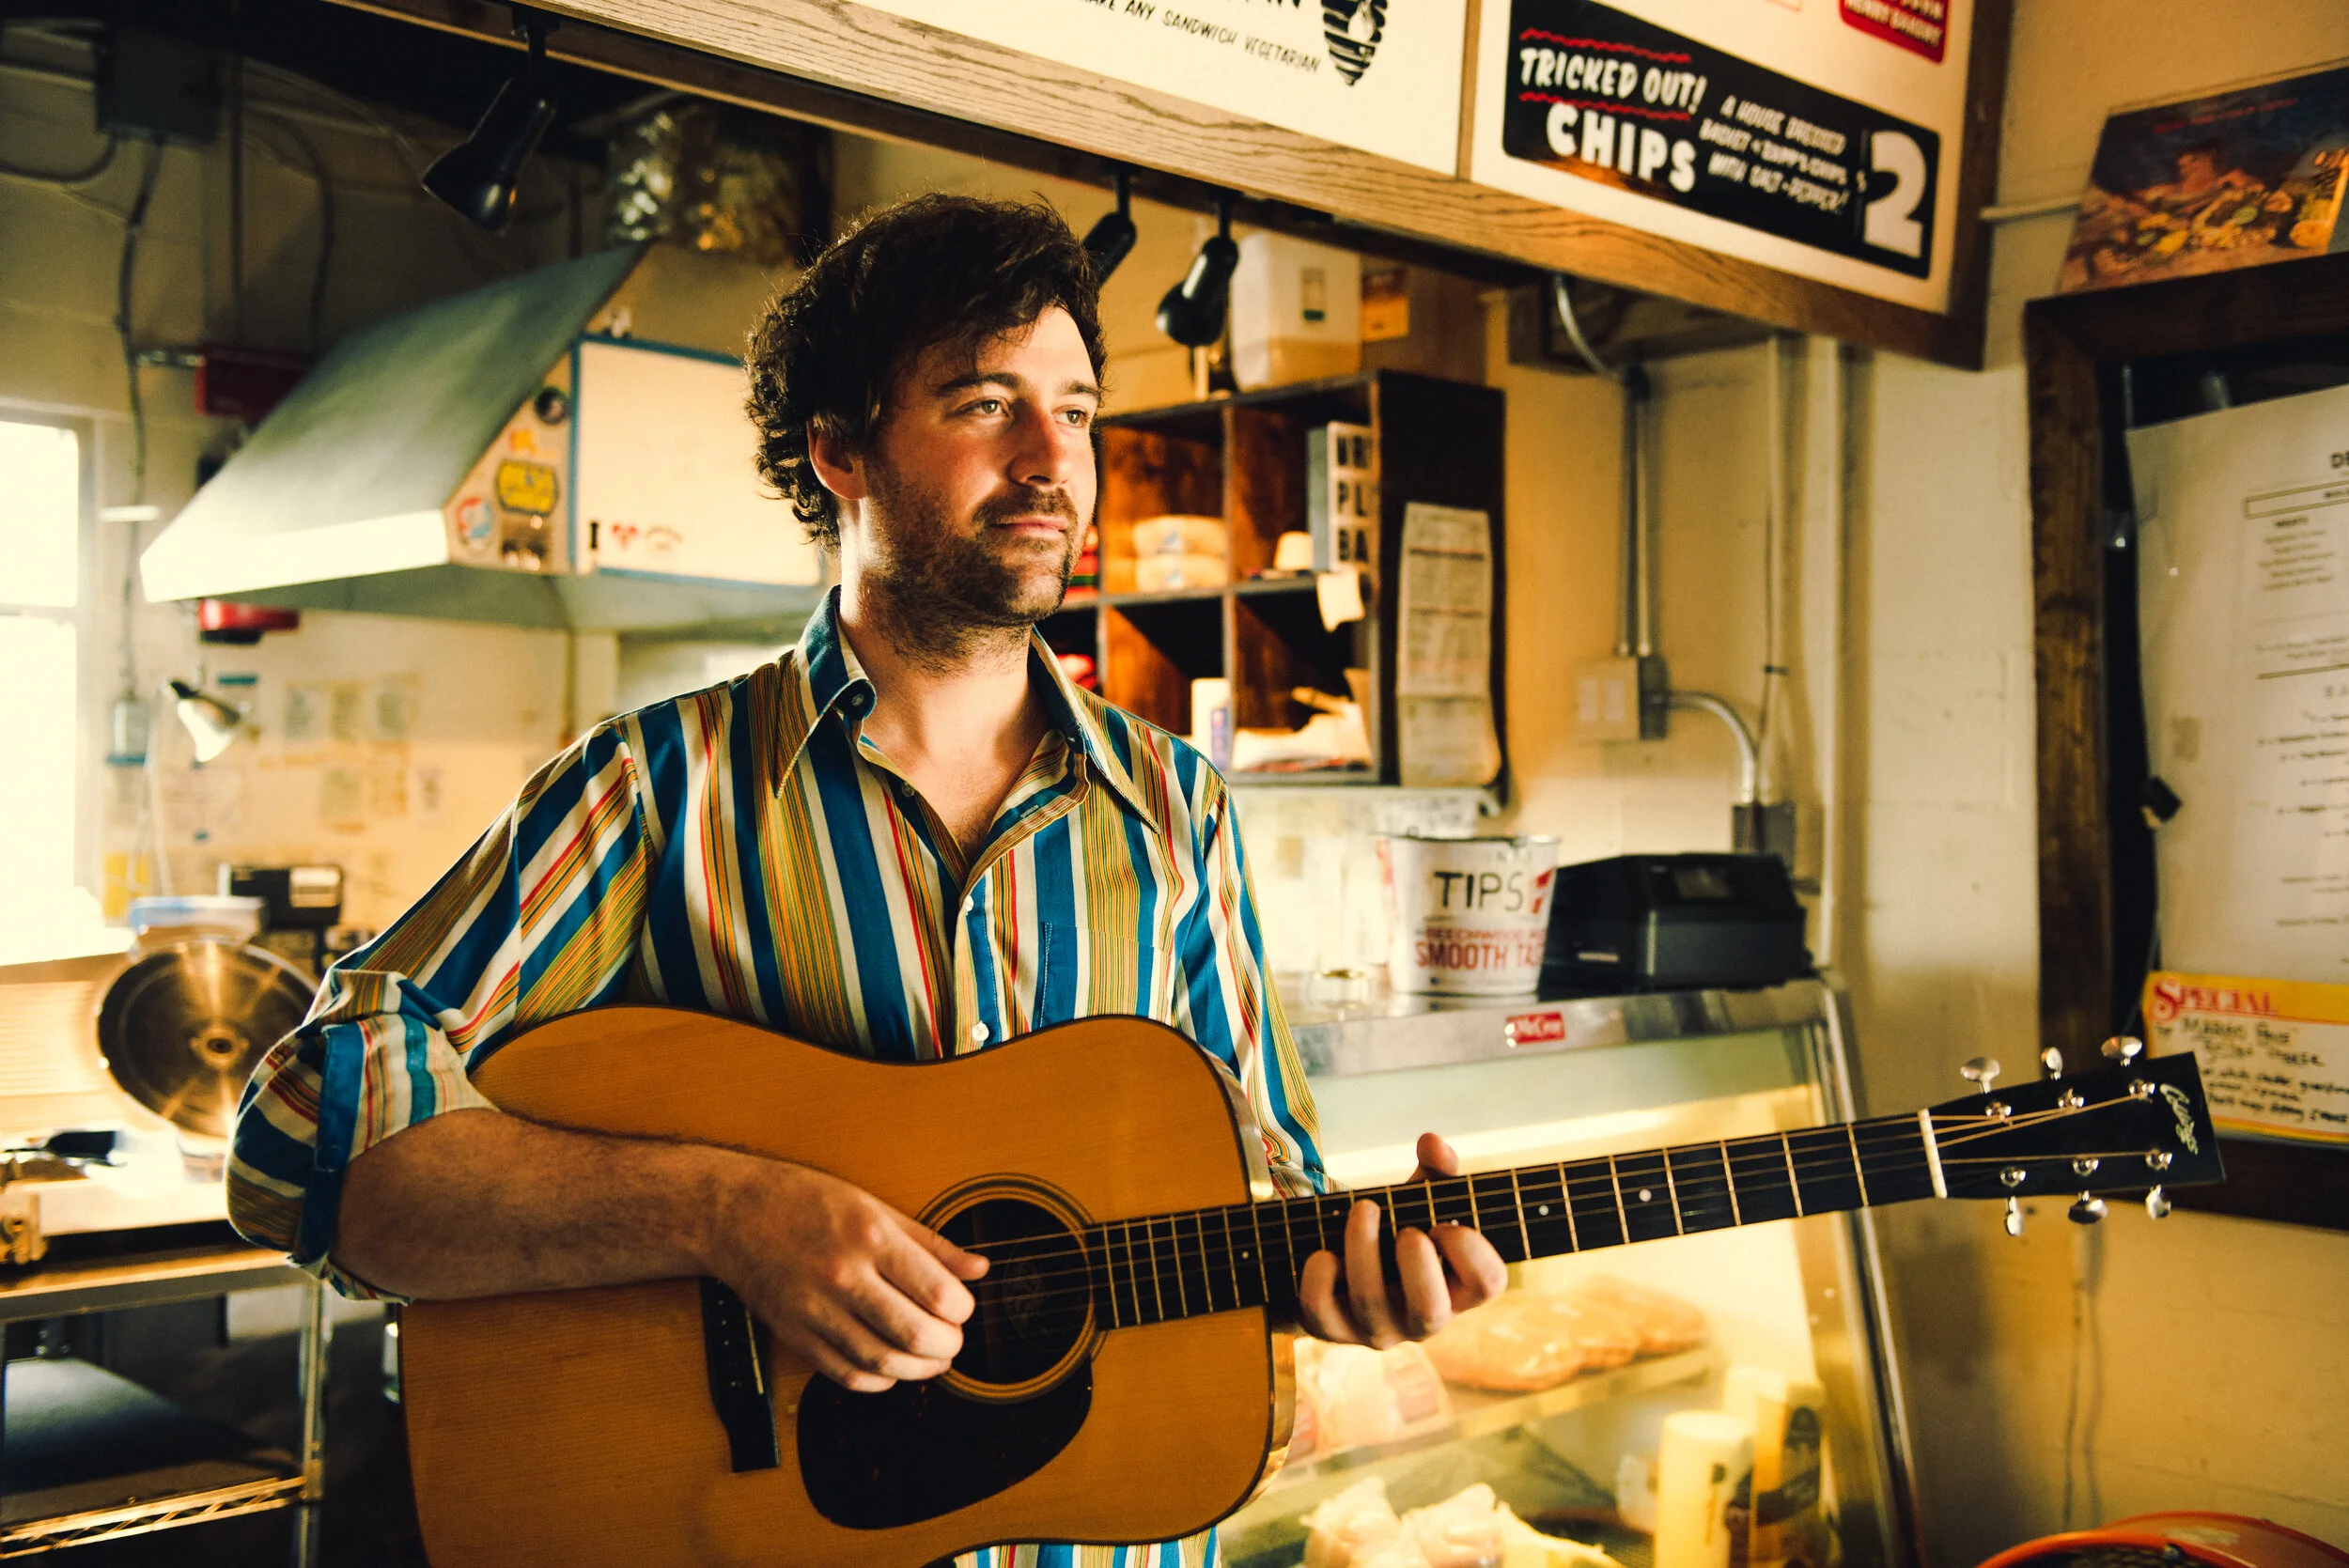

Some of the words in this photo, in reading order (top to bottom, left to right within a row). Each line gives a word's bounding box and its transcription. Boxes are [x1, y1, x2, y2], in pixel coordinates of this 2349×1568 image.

[1125, 0, 1155, 21] ANY
[1161, 9, 1238, 45] SANDWICH
[1245, 35, 1321, 73] VEGETARIAN
[1519, 47, 1639, 100] TRICKED
[1641, 67, 1708, 116] OUT!
[1546, 100, 1696, 193] CHIPS
[1433, 870, 1524, 912] TIPS
[1415, 940, 1510, 970] SMOOTH
